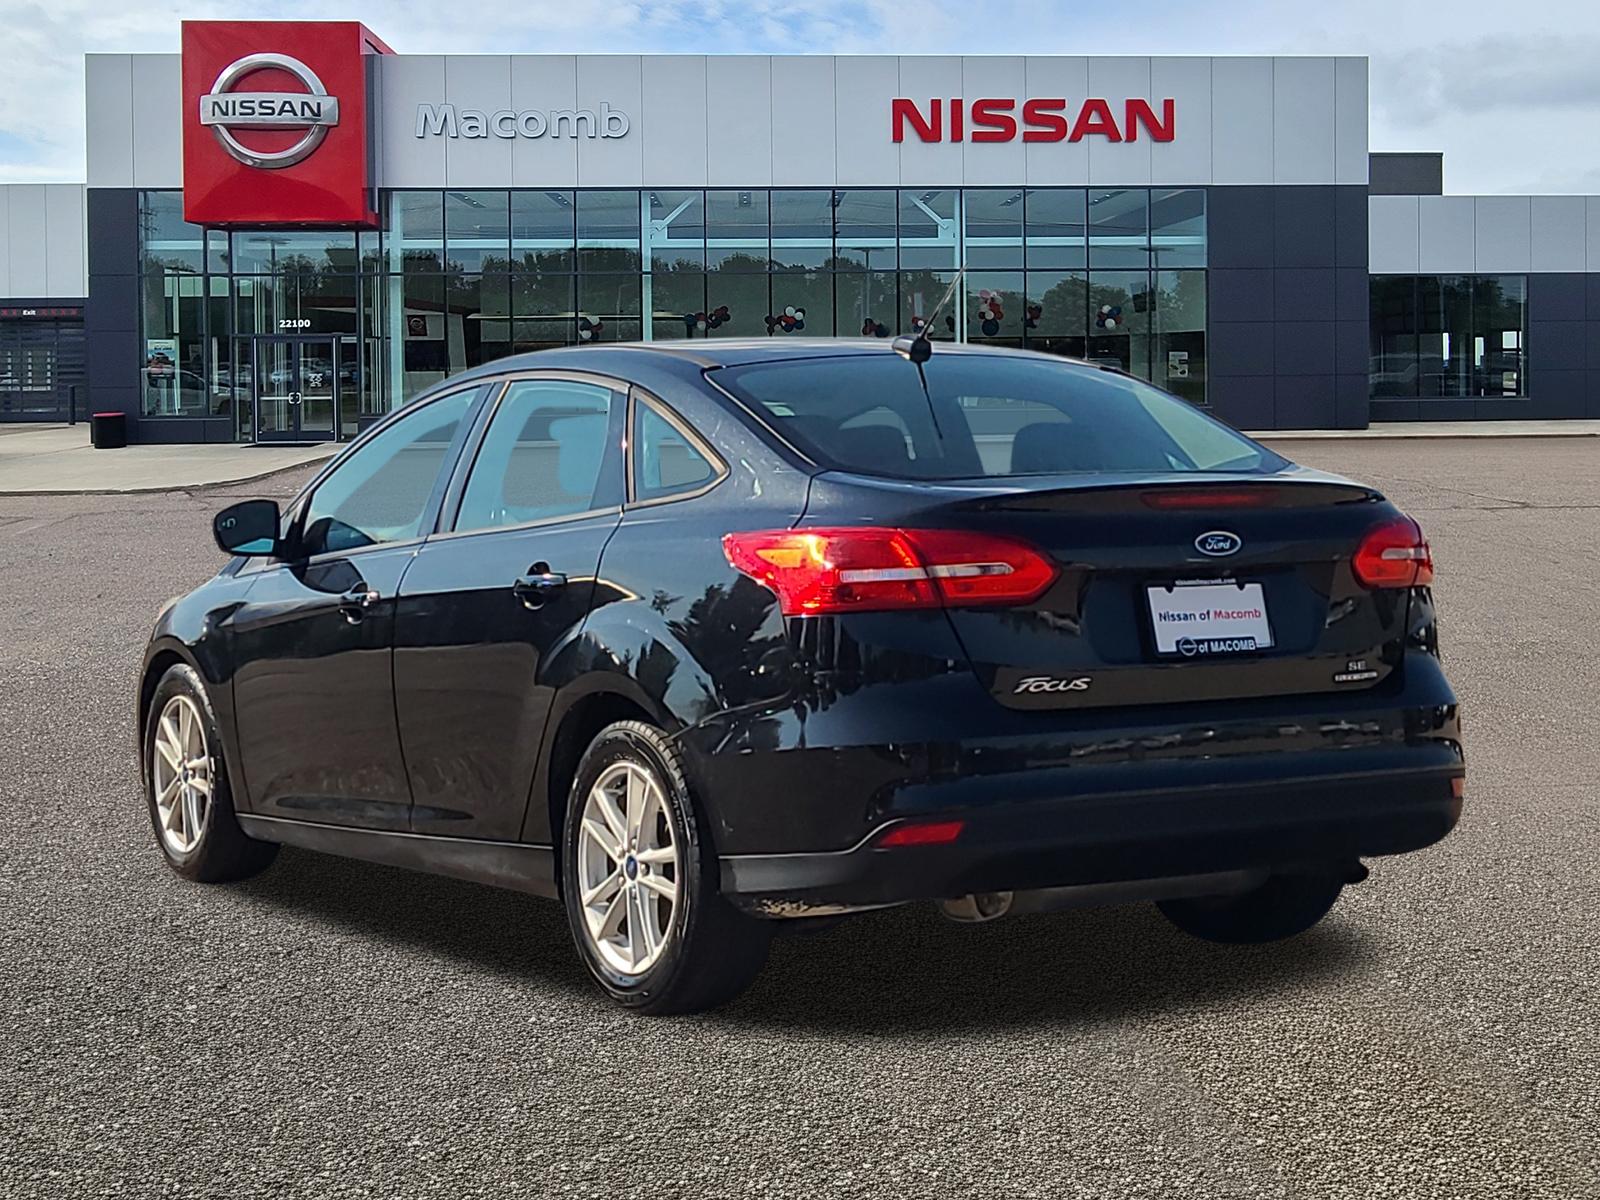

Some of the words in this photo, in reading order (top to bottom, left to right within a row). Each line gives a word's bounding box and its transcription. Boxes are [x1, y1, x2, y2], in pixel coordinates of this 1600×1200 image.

[211, 100, 322, 117] NISSAN
[415, 102, 630, 139] Macomb
[892, 98, 1175, 143] NISSAN
[279, 319, 311, 328] 22100
[1205, 536, 1231, 550] Ford
[1158, 610, 1197, 622] Nissan
[1199, 609, 1210, 621] of
[1213, 608, 1261, 619] Macomb
[1198, 641, 1209, 653] of
[1210, 639, 1256, 652] MACOMB
